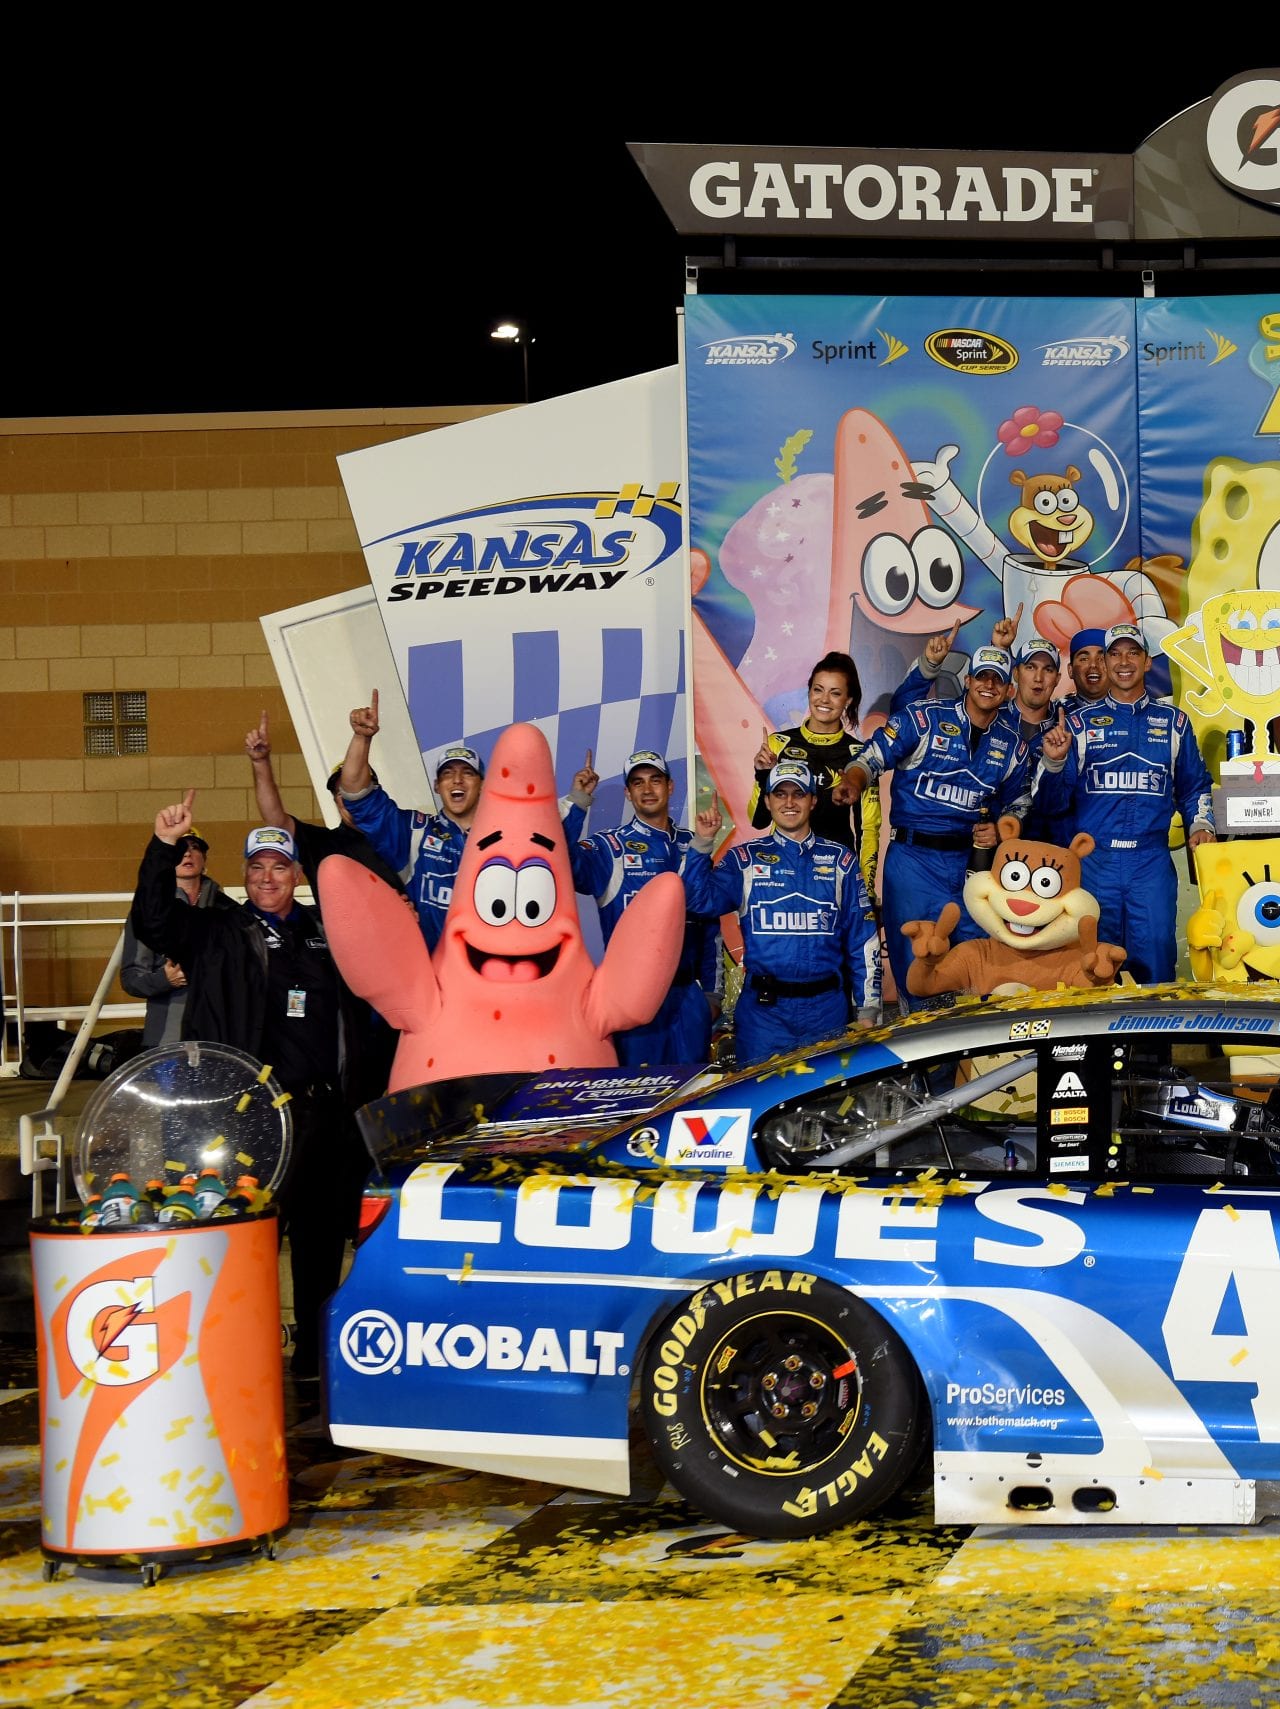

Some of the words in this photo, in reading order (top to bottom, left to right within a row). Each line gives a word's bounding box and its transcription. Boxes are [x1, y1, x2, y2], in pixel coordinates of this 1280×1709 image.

[689, 161, 1094, 223] GATORADE
[707, 342, 780, 358] KANSAS
[812, 340, 877, 364] Sprint
[950, 338, 983, 348] NASCAR
[1043, 345, 1113, 359] KANSAS
[1142, 341, 1206, 366] Sprint
[956, 348, 988, 361] Sprint
[392, 519, 637, 578] KANSAS
[386, 570, 629, 602] SPEEDWAY
[1093, 769, 1161, 791] LOWE'S
[925, 778, 985, 808] LOWE'
[1244, 807, 1274, 818] WINNER!
[760, 908, 830, 931] LOWE'S
[1107, 1013, 1181, 1031] Jimmie
[1184, 1012, 1275, 1032] Johnson
[1051, 1043, 1089, 1057] Hendrick
[1051, 1090, 1088, 1099] AXALTA
[678, 1148, 733, 1159] Valvoline
[406, 1321, 625, 1376] KOBALT
[653, 1270, 819, 1417] GOODYEAR
[946, 1383, 1066, 1406] ProServices
[947, 1415, 1059, 1430] www.bethematch.org
[781, 1431, 890, 1519] EAGLE
